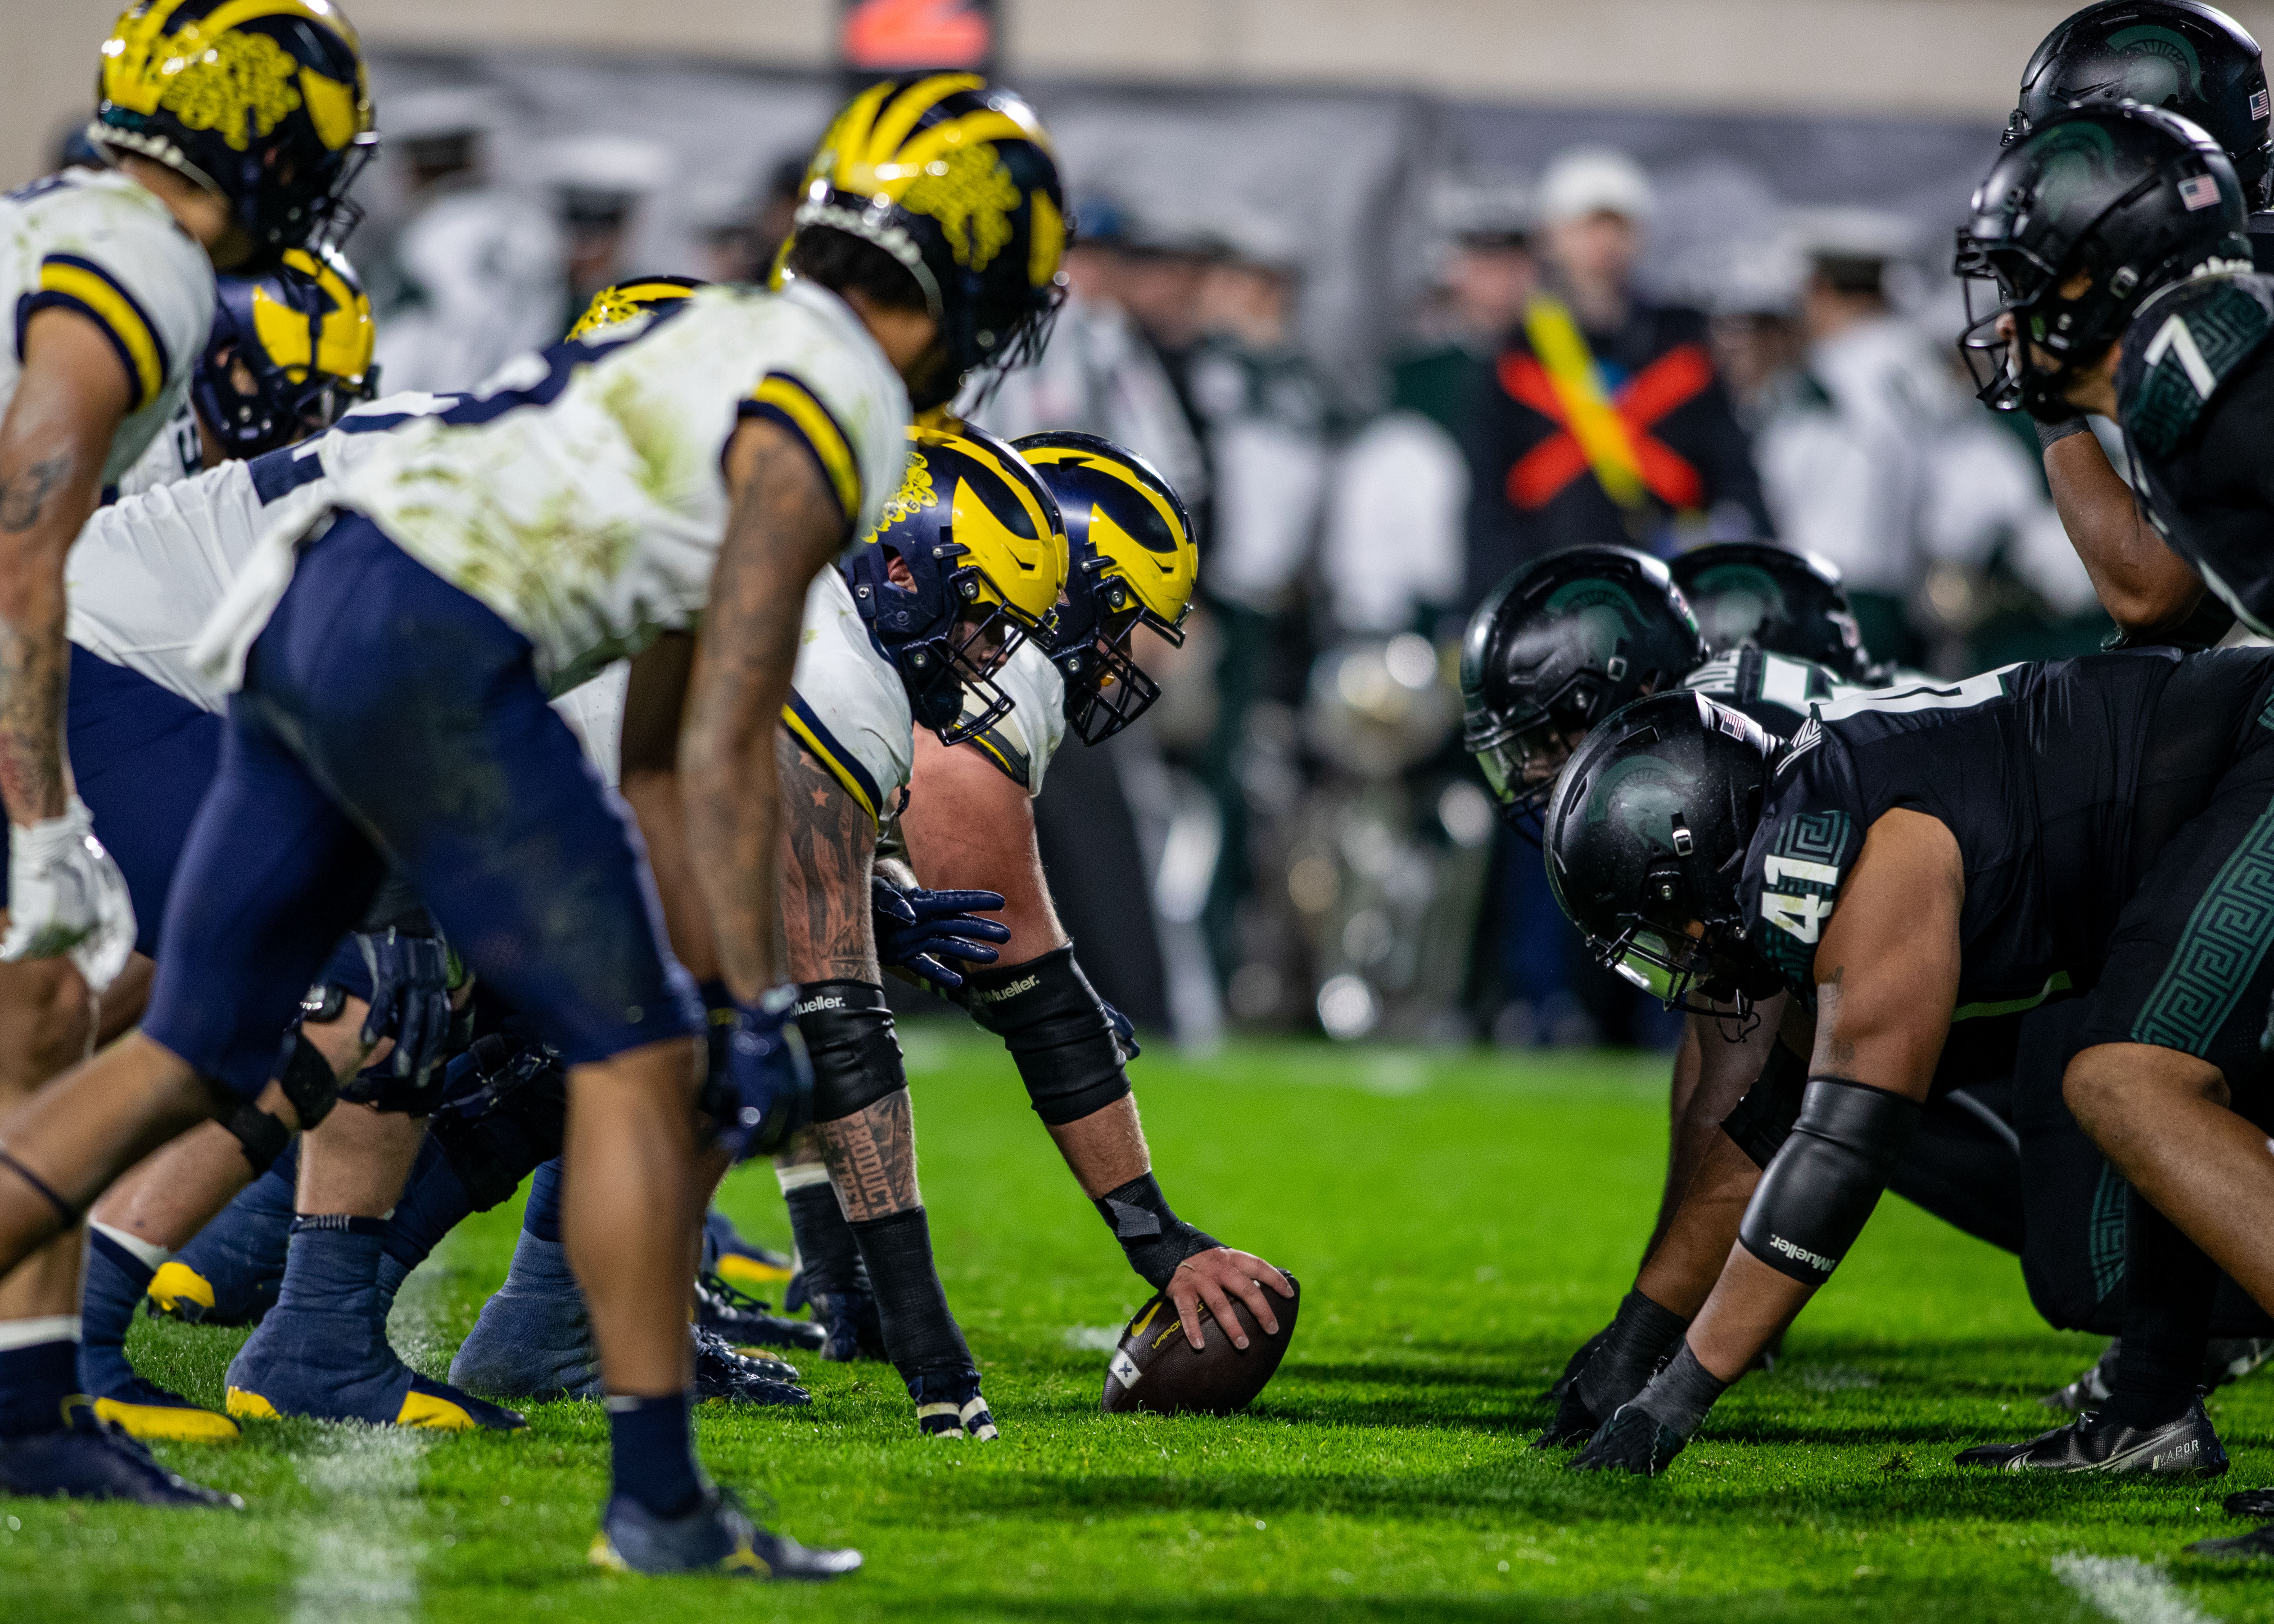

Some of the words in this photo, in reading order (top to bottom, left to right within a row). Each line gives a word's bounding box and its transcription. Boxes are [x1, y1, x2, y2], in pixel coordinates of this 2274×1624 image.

[2143, 313, 2218, 399] 7
[1761, 854, 1839, 944] 41
[834, 1155, 871, 1222] TREN
[838, 1110, 899, 1215] PRODUCT
[1769, 1234, 1835, 1272] Mueller.
[2159, 1439, 2199, 1463] VAPOR
